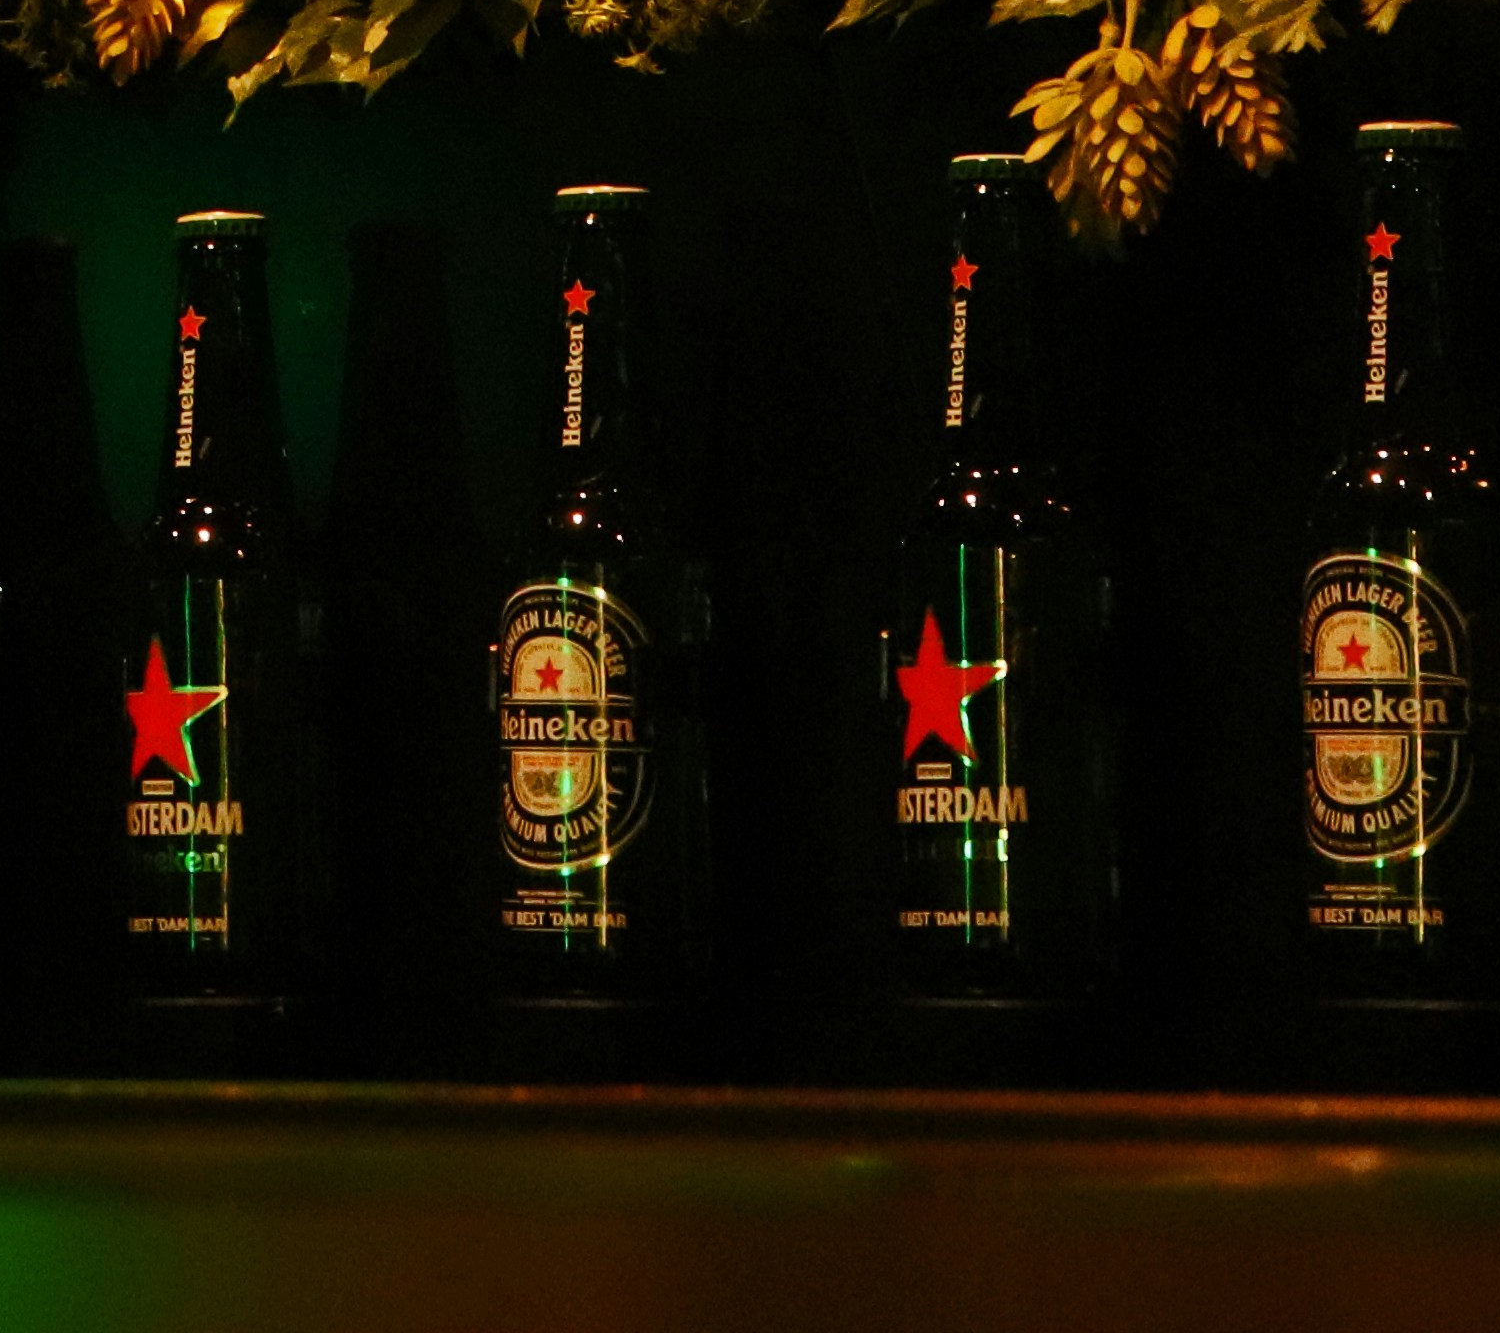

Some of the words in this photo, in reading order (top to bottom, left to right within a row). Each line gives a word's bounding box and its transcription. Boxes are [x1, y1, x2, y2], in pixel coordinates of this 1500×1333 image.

[562, 324, 584, 447] Heineken
[945, 300, 967, 427] Heineken
[1365, 271, 1387, 404] Heineken
[175, 349, 195, 468] Heineken
[544, 609, 597, 640] LAGER
[1347, 582, 1404, 614] LAGER
[126, 801, 244, 836] STERDAM
